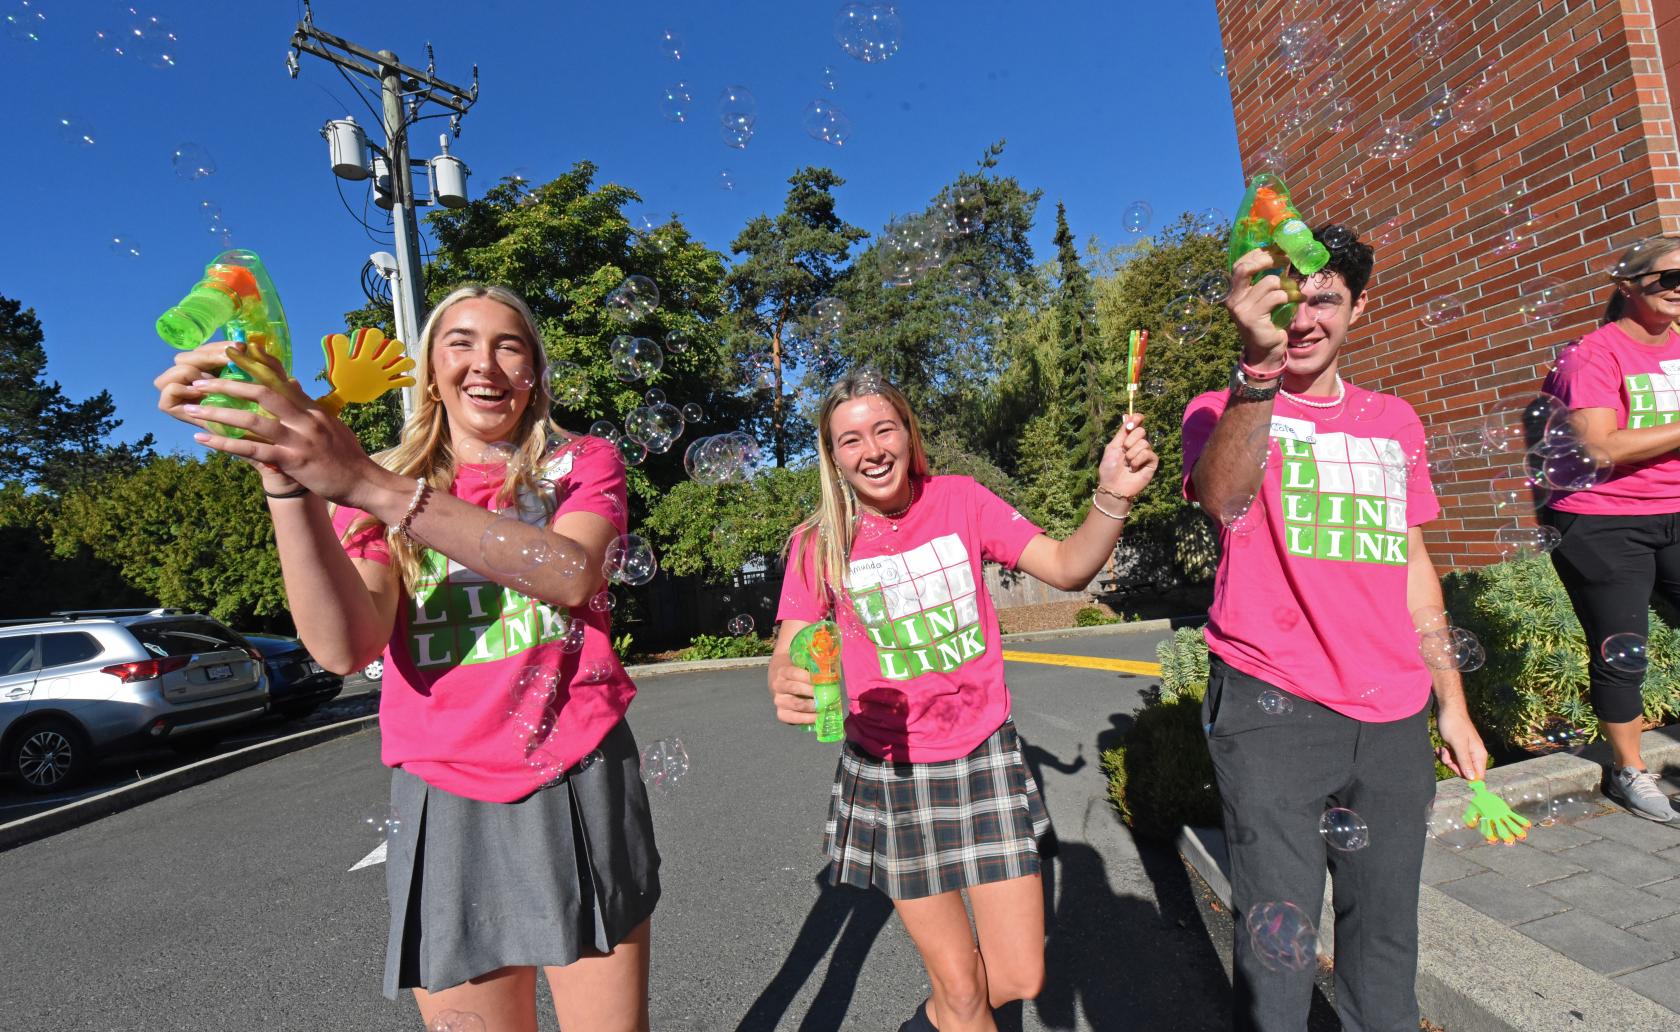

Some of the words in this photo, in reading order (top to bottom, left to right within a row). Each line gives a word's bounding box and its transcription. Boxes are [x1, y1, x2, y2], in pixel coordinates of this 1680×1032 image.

[1285, 495, 1407, 532] LINE
[1288, 526, 1407, 563] LINK
[414, 605, 567, 667] LINK
[869, 598, 979, 650] LINE
[881, 626, 986, 679] LINK
